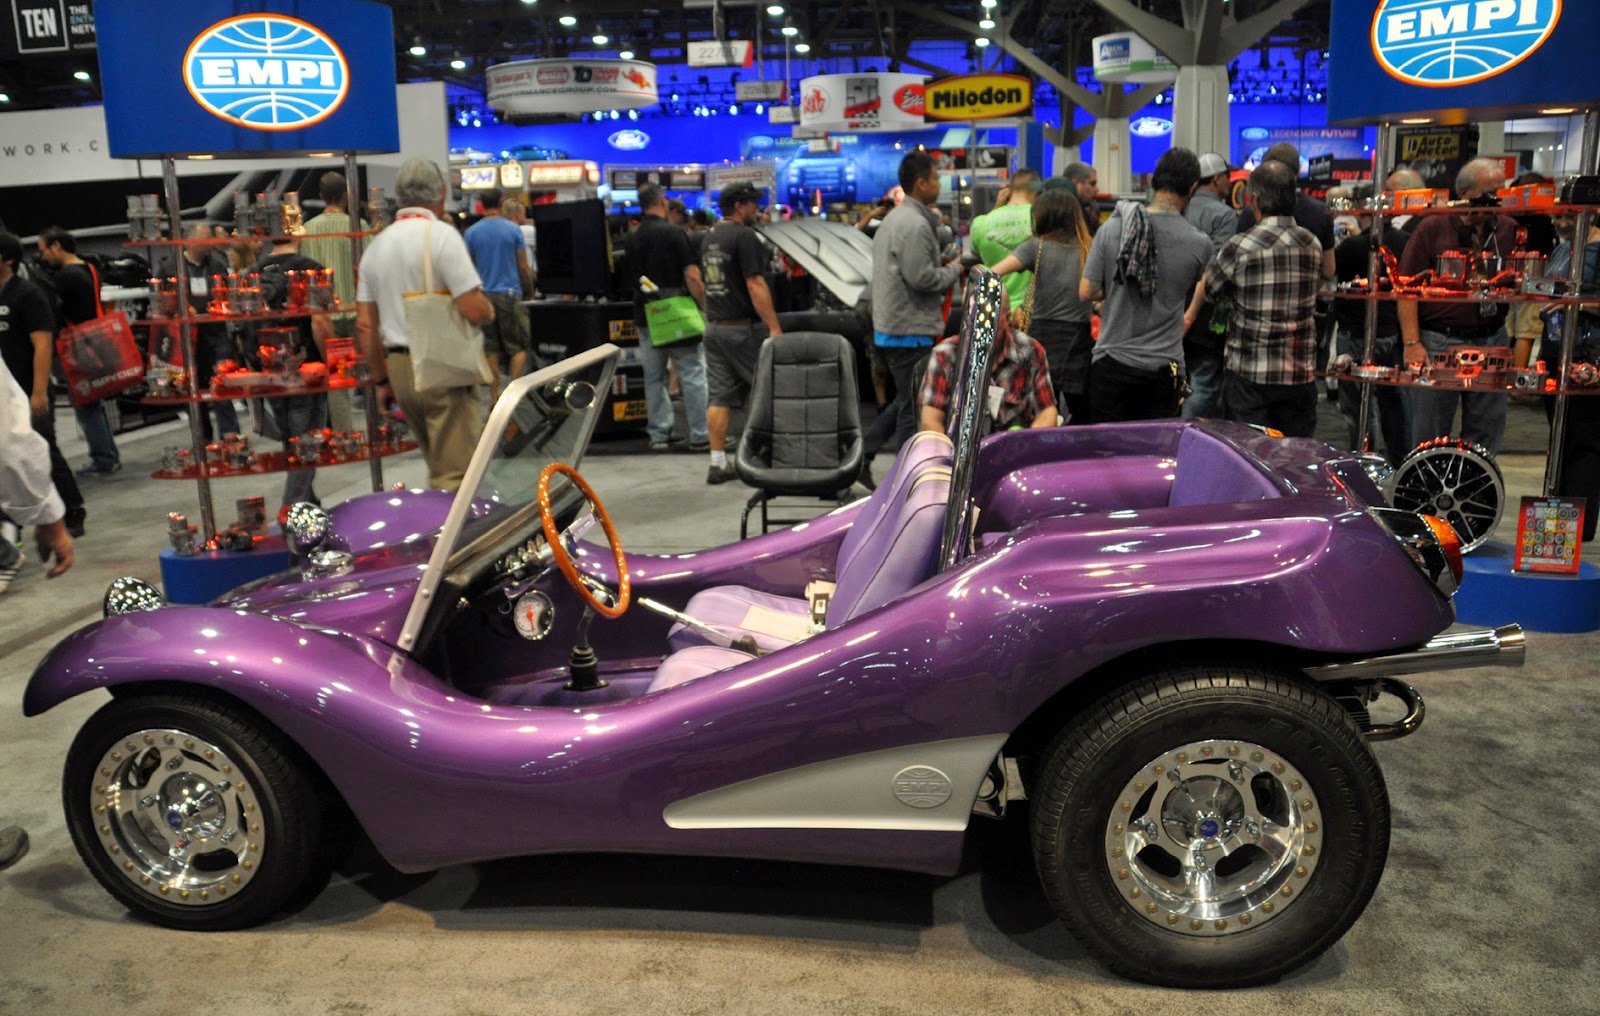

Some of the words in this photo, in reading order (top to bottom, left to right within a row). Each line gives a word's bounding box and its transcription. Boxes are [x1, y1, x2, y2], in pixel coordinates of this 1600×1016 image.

[21, 7, 57, 38] TEN
[68, 4, 89, 15] THE
[1386, 0, 1538, 43] EMPI
[200, 58, 336, 88] EMPI
[933, 85, 1022, 110] Milodon
[1270, 129, 1320, 138] LEGENDARY
[1320, 128, 1358, 138] FUTURE
